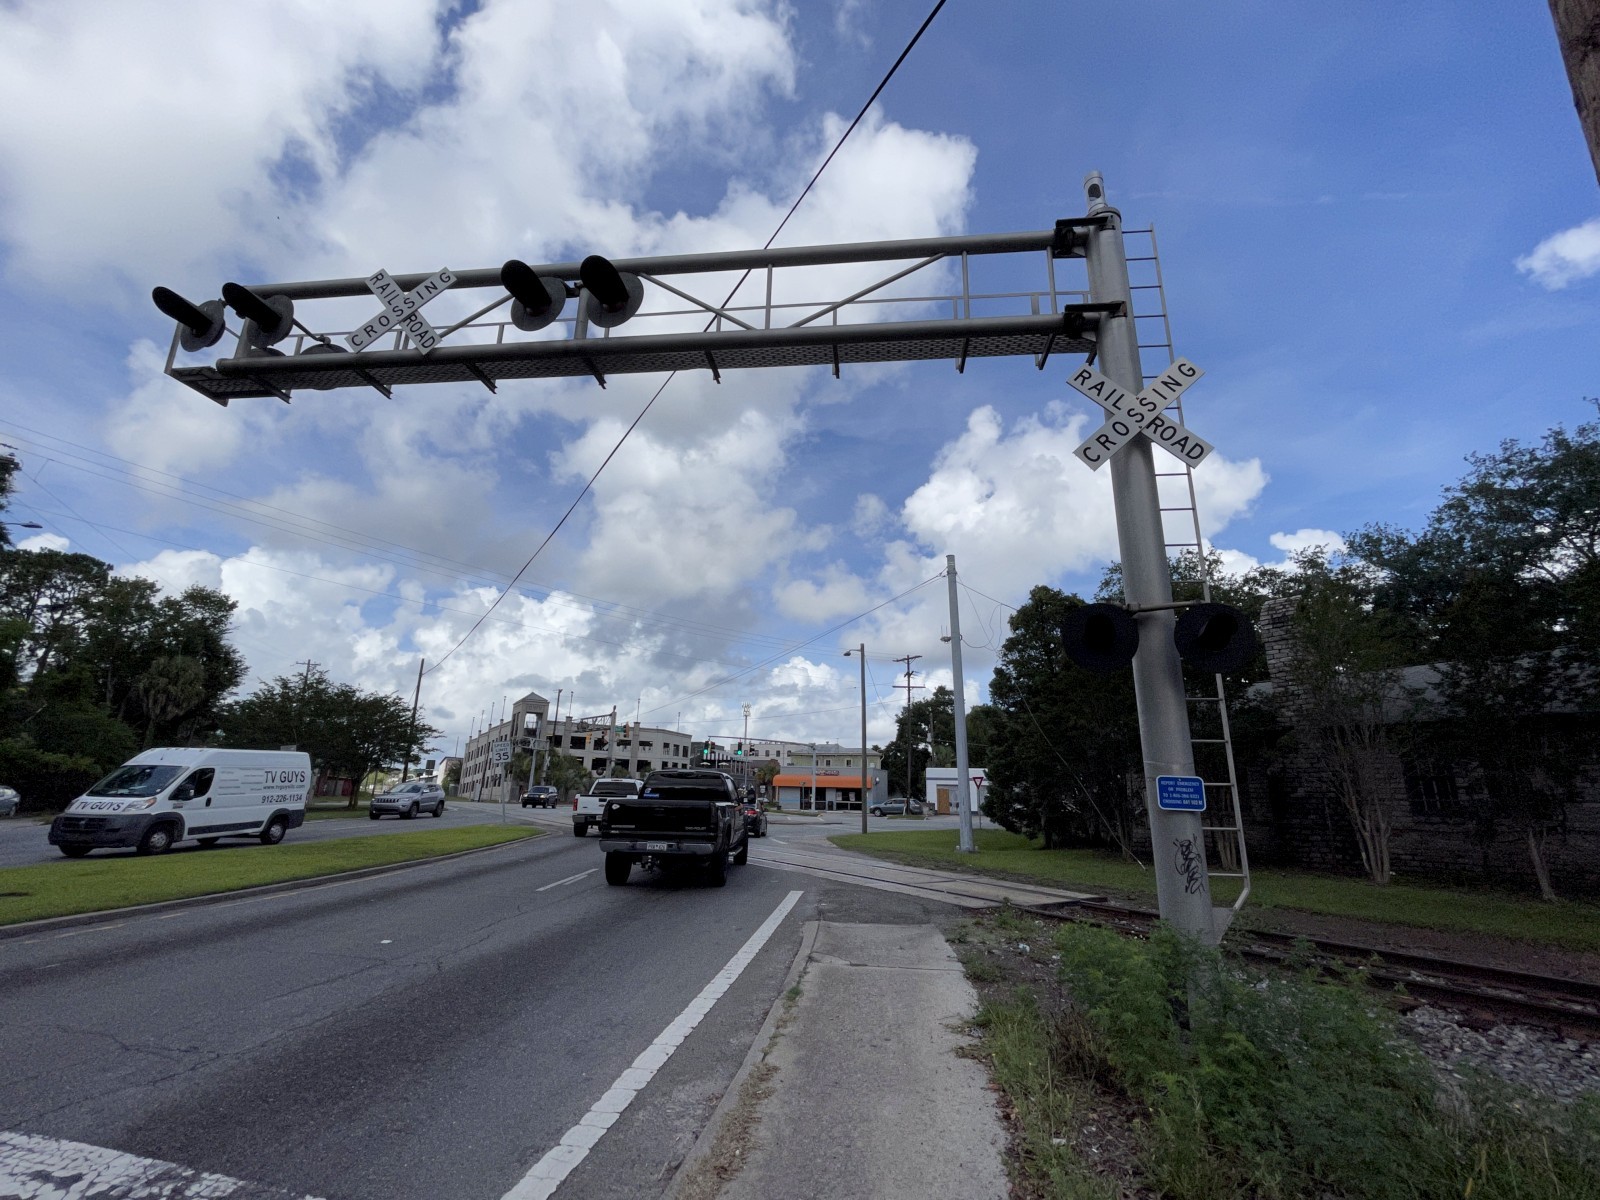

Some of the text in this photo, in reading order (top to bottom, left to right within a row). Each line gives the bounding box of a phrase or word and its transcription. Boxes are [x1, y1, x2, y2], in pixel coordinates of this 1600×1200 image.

[352, 272, 450, 346] CROSSING
[370, 272, 435, 349] RAIL ROAD
[1074, 369, 1205, 460] RAIL ROAD
[1083, 363, 1196, 462] CROSSING
[264, 770, 306, 783] TV GUYS
[495, 752, 509, 761] 35
[75, 801, 124, 811] TV GUYS
[261, 794, 302, 803] 912-226-1134
